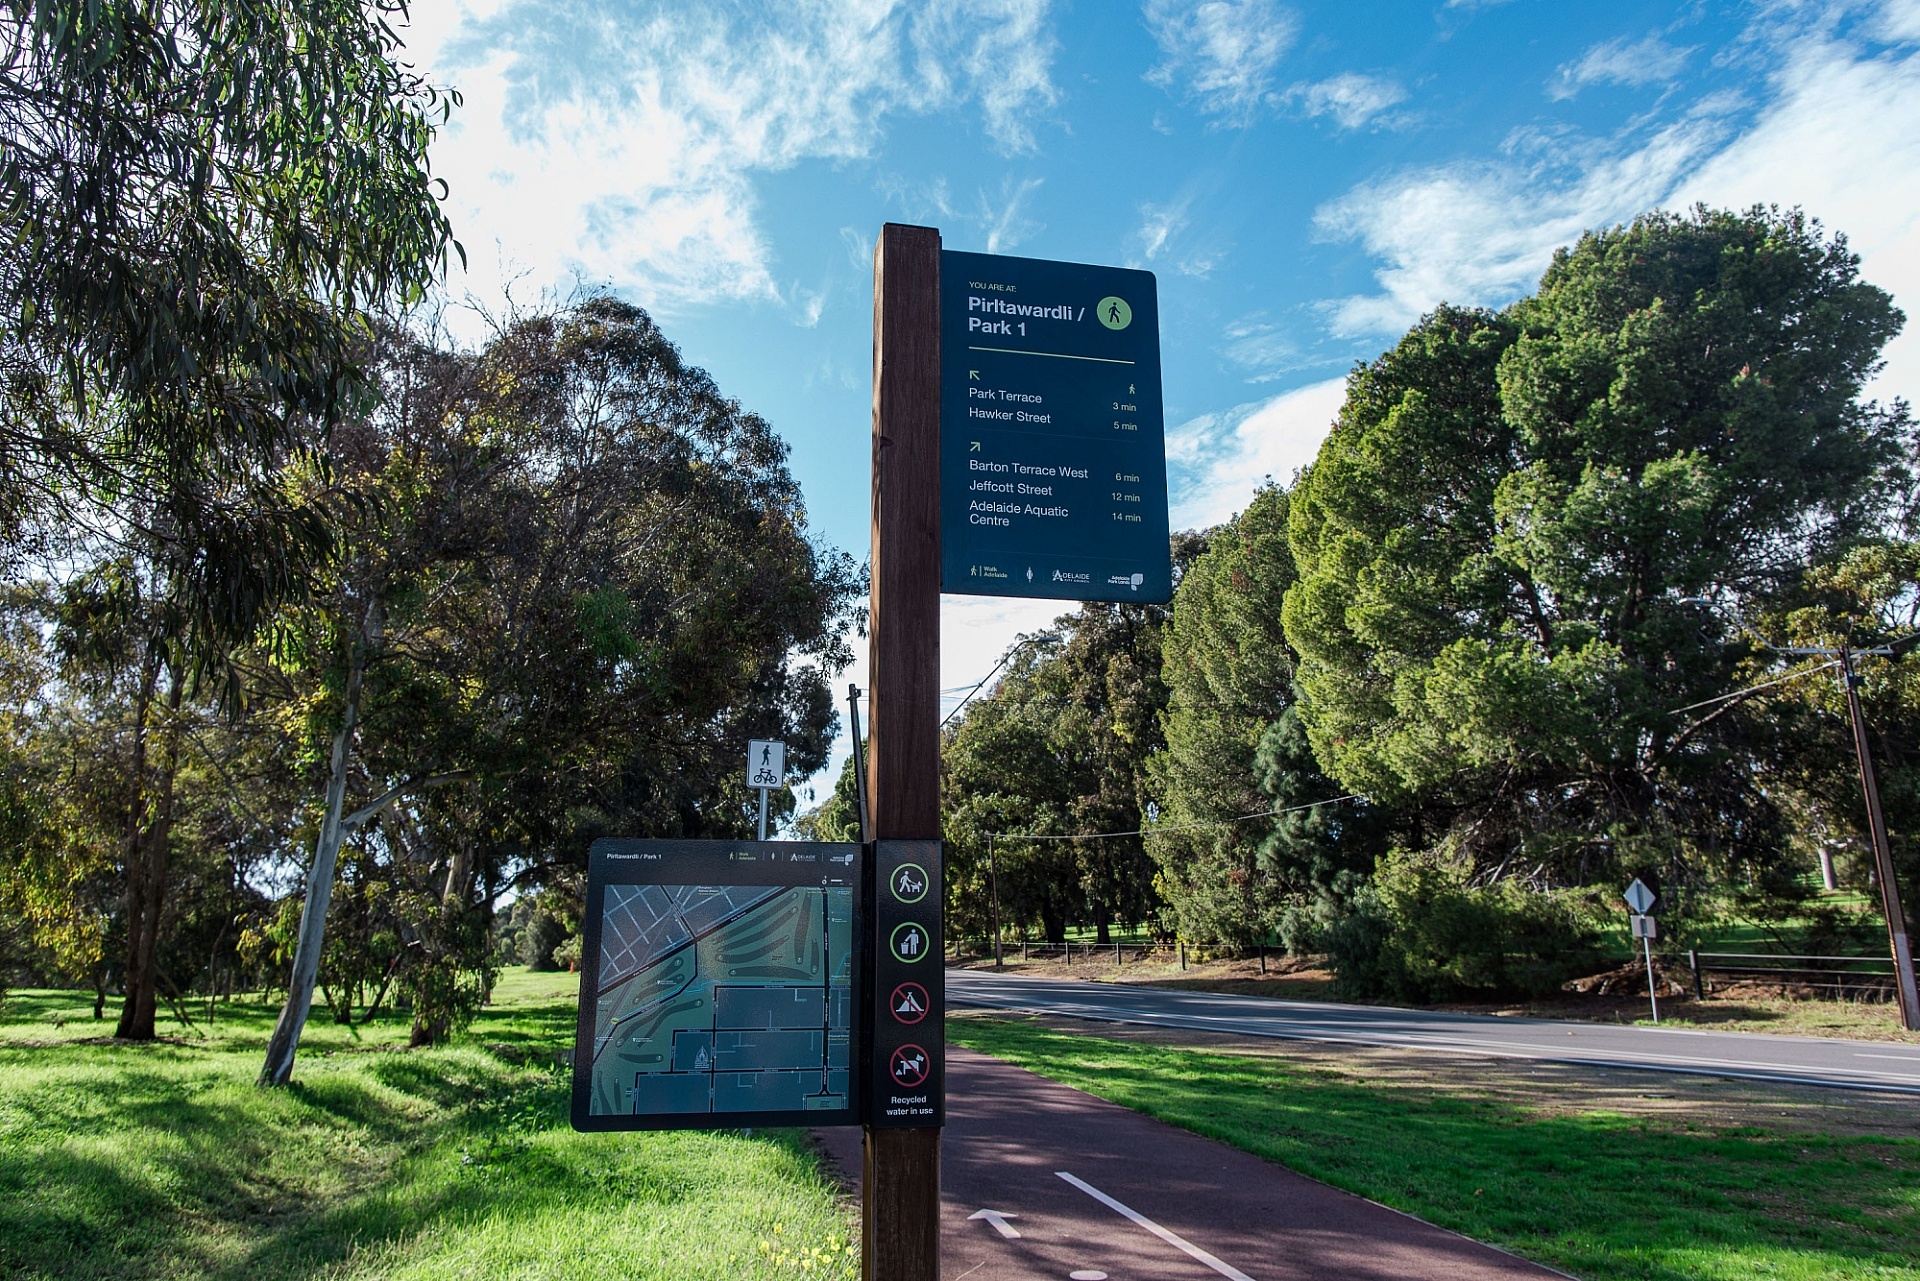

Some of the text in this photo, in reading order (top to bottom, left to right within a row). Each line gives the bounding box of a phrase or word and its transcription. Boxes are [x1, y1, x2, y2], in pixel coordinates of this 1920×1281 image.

[969, 281, 986, 290] YOU
[968, 296, 1085, 322] Pirltawardli /
[968, 317, 1026, 336] Park 1
[969, 388, 1042, 404] Park Terrace
[1112, 402, 1137, 412] 3 min
[969, 407, 1051, 424] Hawker Street
[1122, 422, 1138, 431] min
[970, 460, 1088, 479] Barton Terrace West
[1115, 473, 1140, 483] 6 min
[969, 480, 1052, 496] Jeffcott Street
[1112, 493, 1140, 502] 12 min
[969, 500, 1069, 518] Adelaide Aquatic
[970, 514, 1010, 526] Centre
[1112, 513, 1141, 522] 14 min
[1052, 569, 1090, 581] ADELAIDE
[891, 1095, 926, 1105] Recycled
